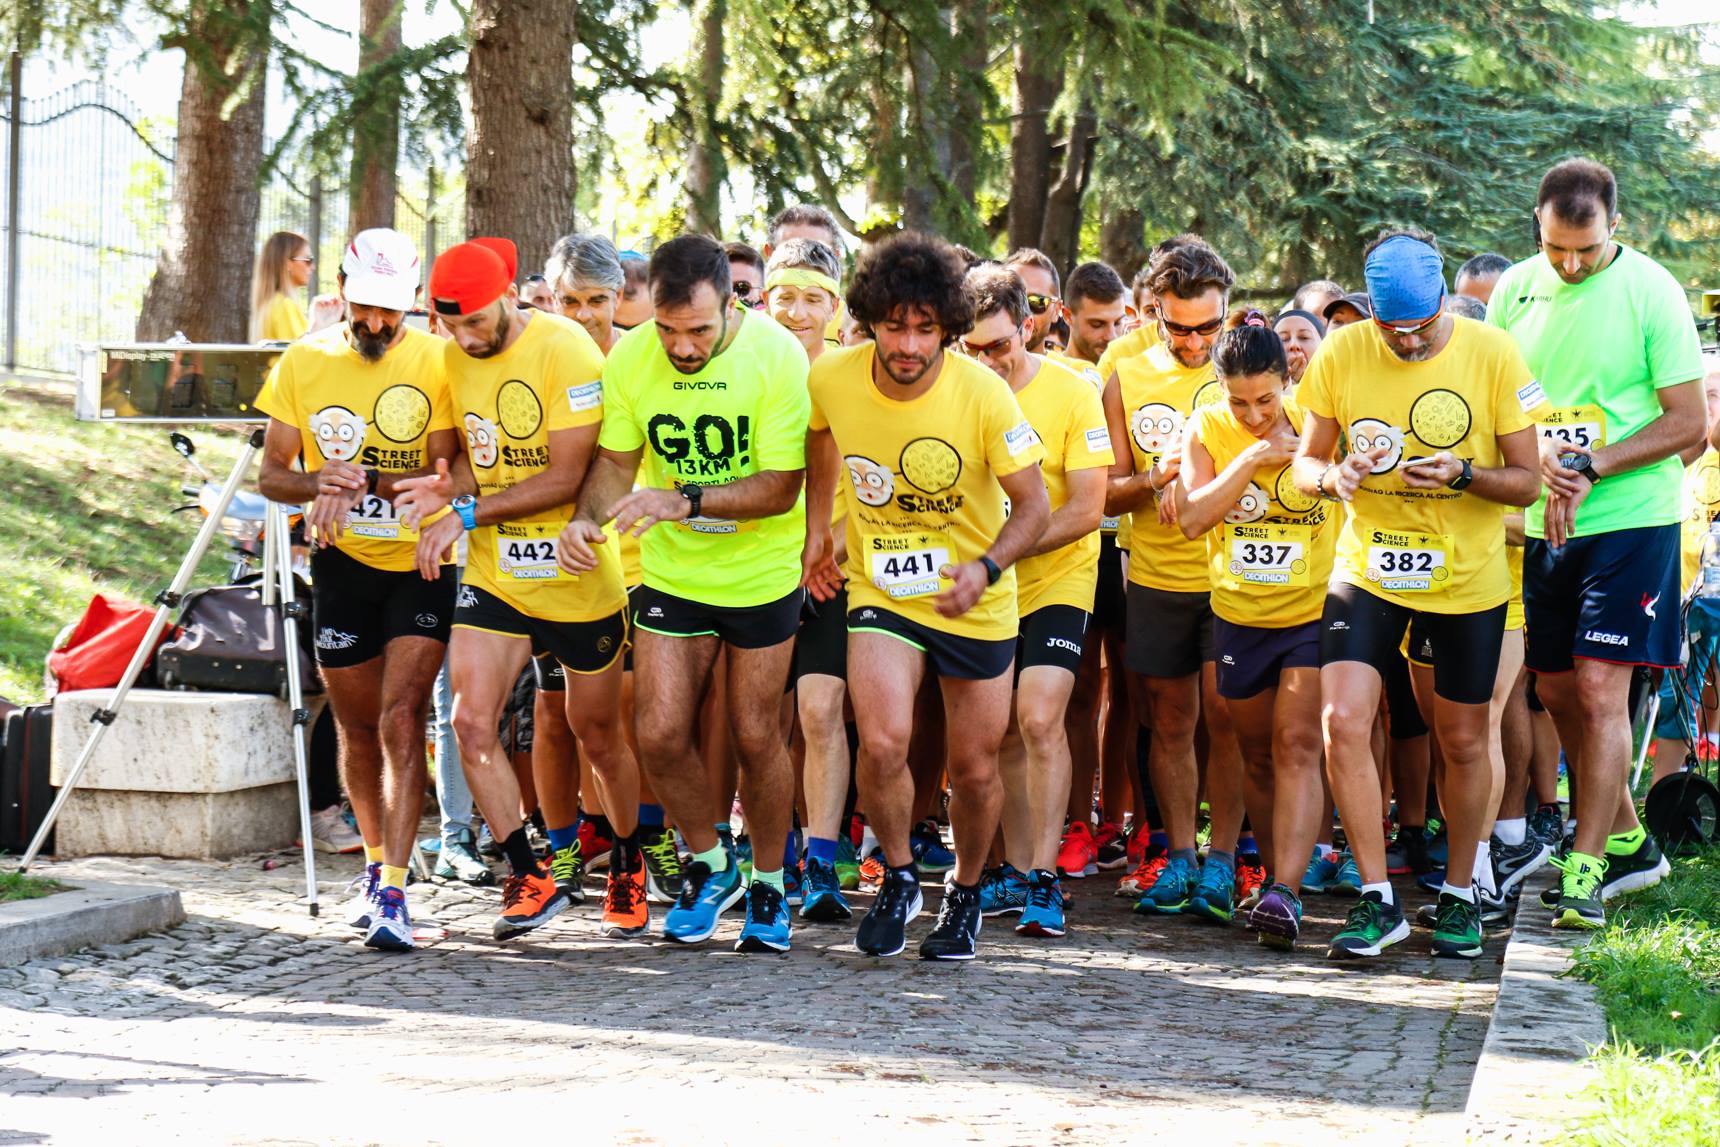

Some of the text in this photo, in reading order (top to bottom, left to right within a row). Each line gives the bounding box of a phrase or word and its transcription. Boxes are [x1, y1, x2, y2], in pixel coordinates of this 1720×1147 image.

[673, 382, 727, 390] GIVOVA
[648, 413, 750, 468] GO!
[361, 446, 421, 466] STREET
[692, 523, 736, 533] DECATHLON
[1234, 526, 1269, 537] STREET
[1372, 532, 1409, 544] STREET
[508, 542, 556, 561] 442
[1242, 544, 1292, 565] 337
[884, 553, 933, 577] 441
[1380, 552, 1432, 572] 382
[513, 569, 558, 579] DECATHLON
[1244, 572, 1289, 583] DECATHLON
[889, 582, 939, 597] DECATHLON
[1381, 580, 1430, 589] DECATHLON
[1585, 631, 1628, 646] LEGEA
